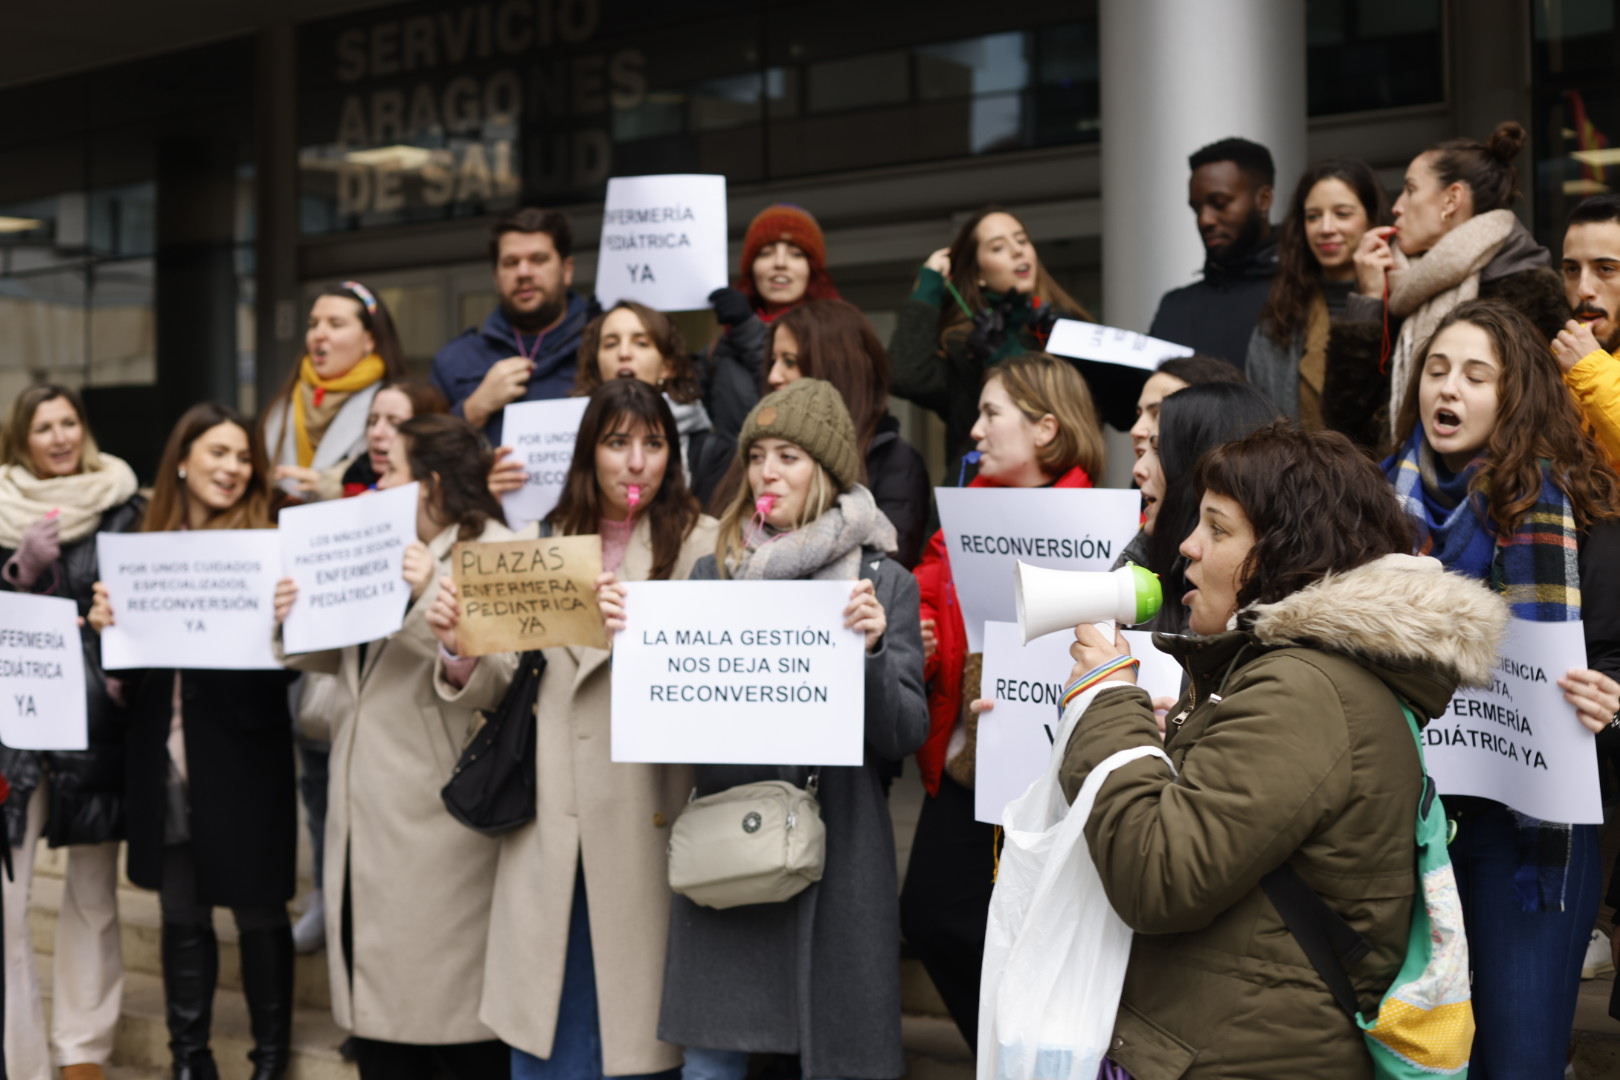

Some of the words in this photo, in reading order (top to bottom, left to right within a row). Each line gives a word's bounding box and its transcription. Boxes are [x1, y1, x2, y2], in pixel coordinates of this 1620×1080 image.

[335, 0, 600, 83] SERVICIO
[338, 167, 405, 216] DE
[421, 128, 613, 208] SALUD
[627, 264, 655, 283] YA
[519, 434, 541, 445] POR
[960, 533, 1111, 559] RECONVERSIÓN
[119, 563, 146, 574] POR
[152, 561, 189, 573] UNOS
[195, 560, 261, 573] CUIDADOS
[462, 547, 564, 575] PLAZAS
[462, 579, 577, 598] ENFERMERA
[128, 596, 258, 612] RECONVERSIÓN
[185, 620, 206, 632] YA
[518, 616, 546, 634] YA
[0, 628, 66, 650] FERMERÍA
[643, 630, 668, 646] LA
[675, 630, 733, 646] MALA
[740, 626, 836, 649] GESTIÓN,
[668, 657, 711, 673] NOS
[718, 657, 771, 673] DEJA
[778, 657, 811, 673] SIN
[1497, 657, 1548, 683] IENCIA
[650, 681, 828, 703] RECONVERSIÓN
[14, 695, 37, 716] YA
[1446, 698, 1533, 736] ERMERÍA
[1521, 746, 1548, 770] YA
